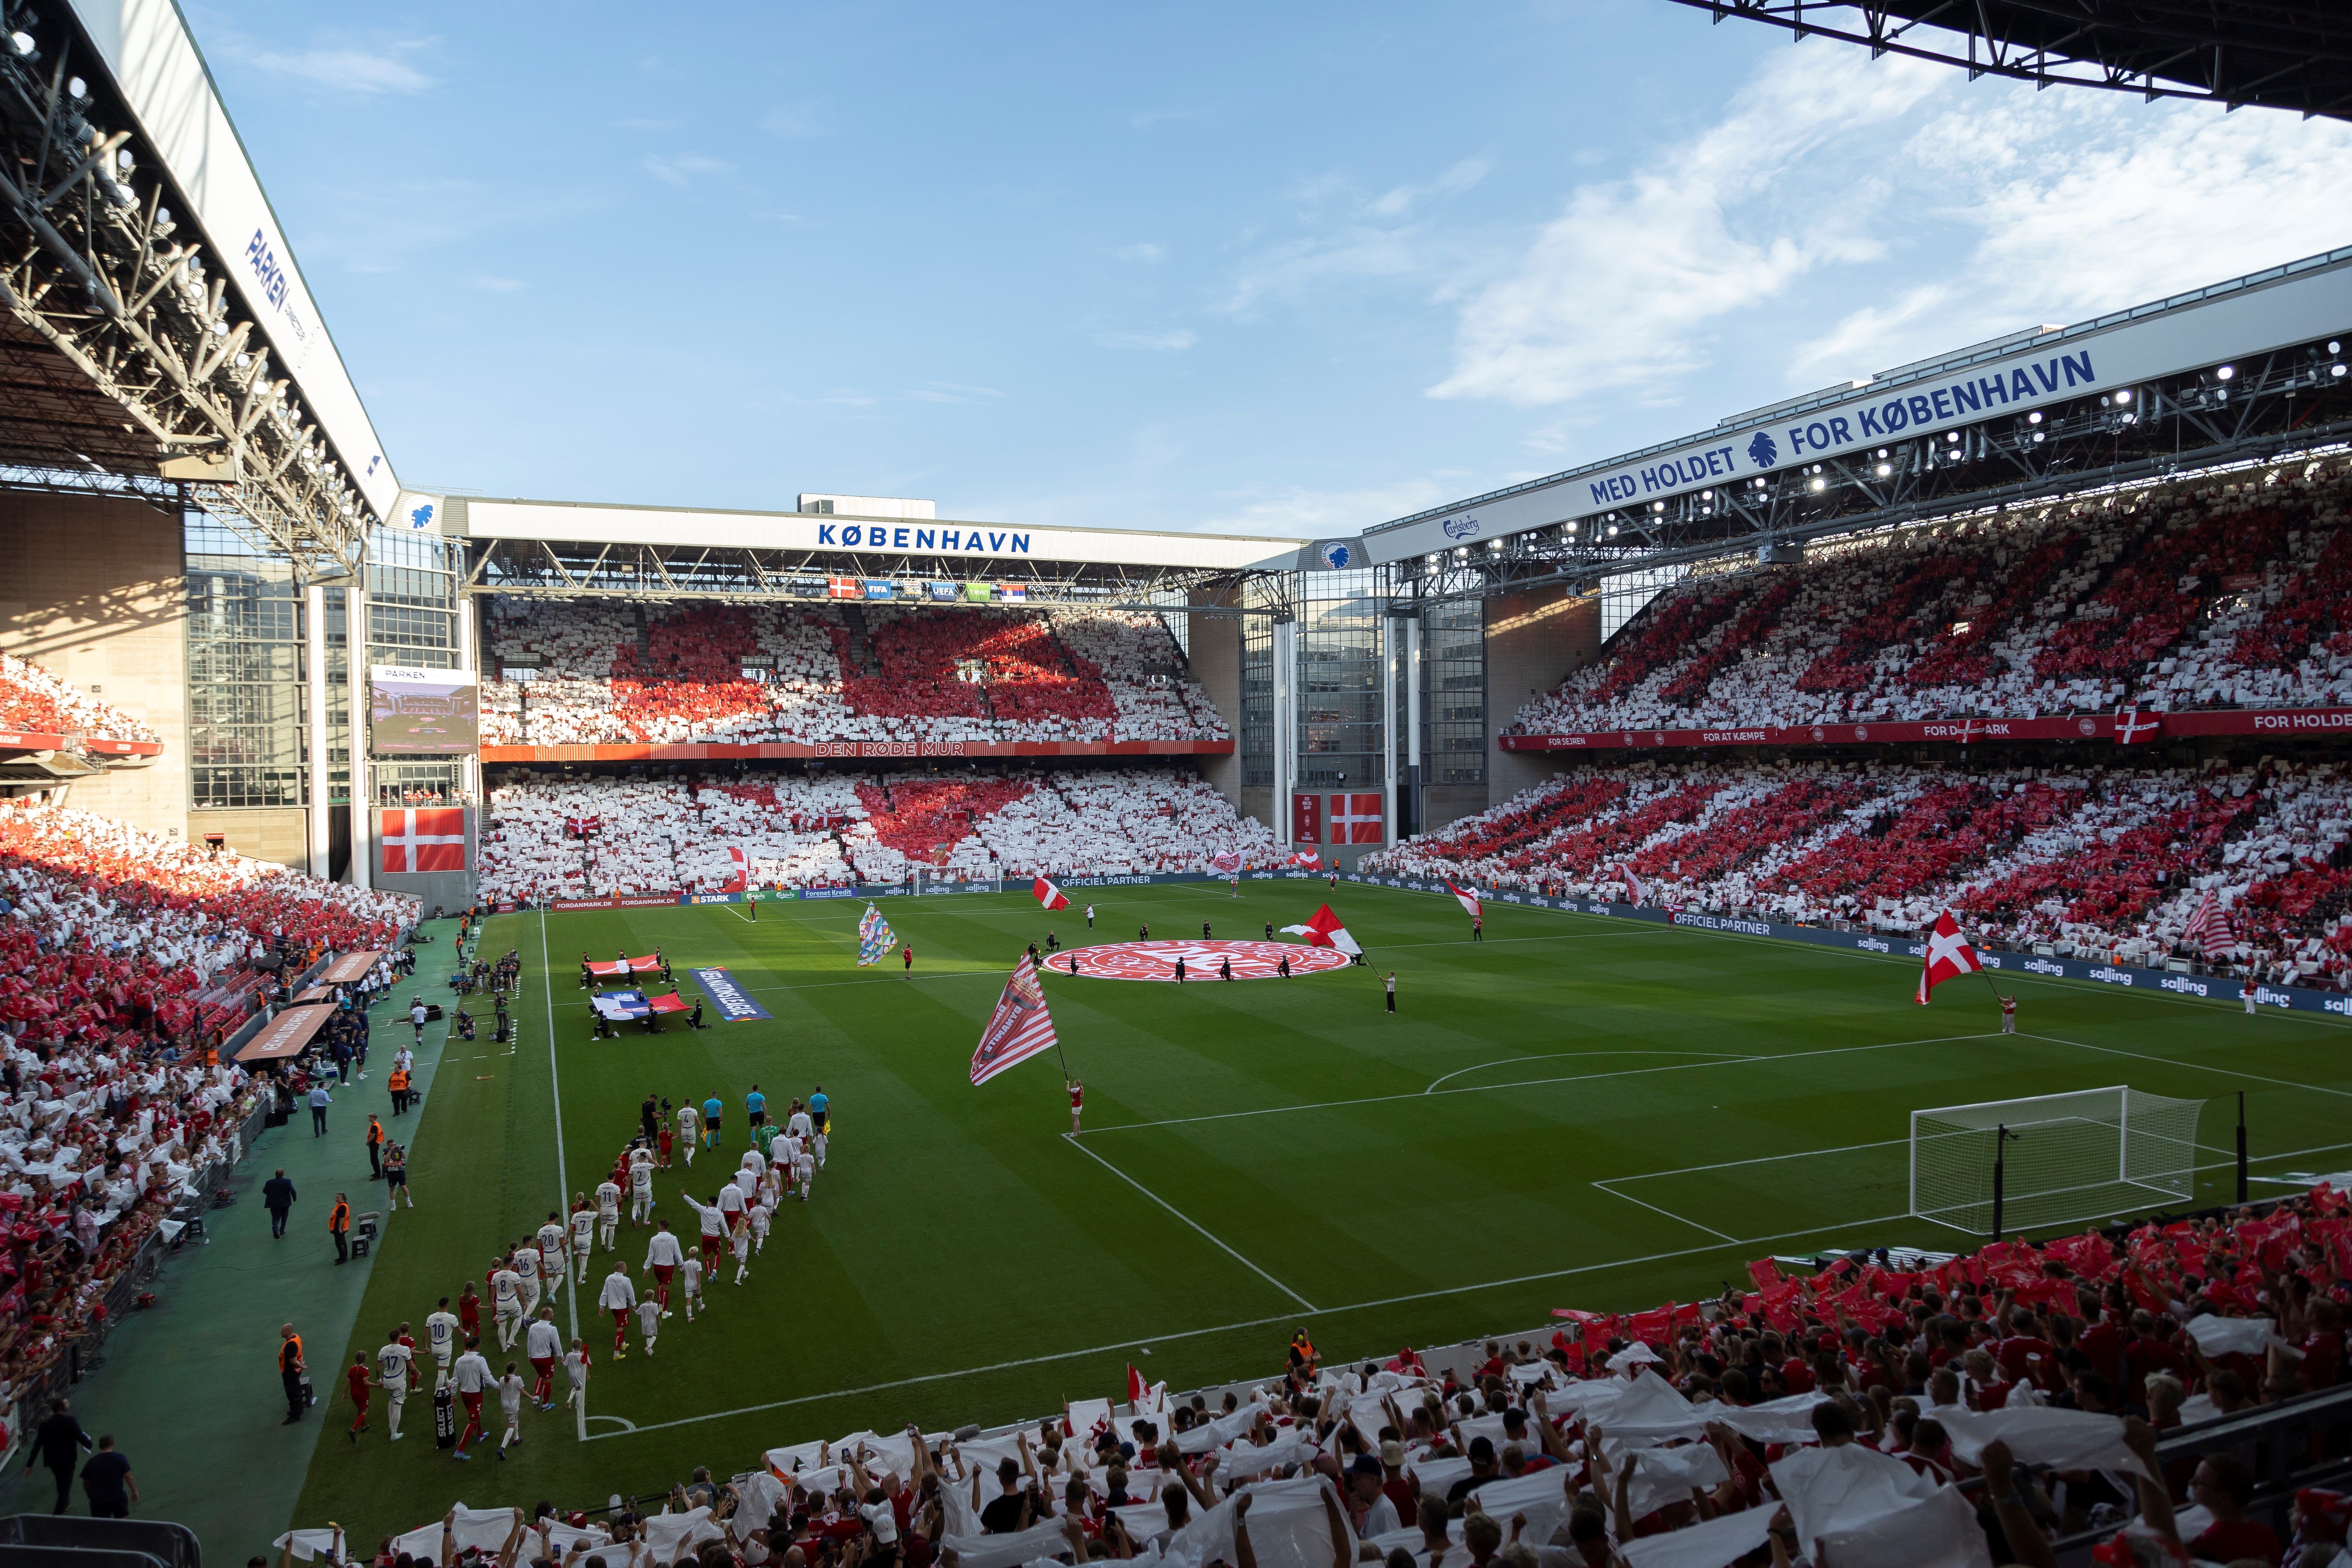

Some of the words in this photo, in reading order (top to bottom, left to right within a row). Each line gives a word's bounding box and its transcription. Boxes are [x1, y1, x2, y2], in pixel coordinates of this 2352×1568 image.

[245, 227, 290, 313] PARKEN
[1590, 475, 1636, 504] MED
[1644, 447, 1734, 492] HOLDET
[1789, 417, 1853, 454] FOR
[1858, 351, 2095, 436] KØBENHAVN
[1443, 517, 1480, 540] Carlsberg
[819, 525, 1029, 552] KØBENHAVN
[1323, 542, 1342, 552] KØBENHAVN
[386, 670, 425, 679] PARKEN
[2254, 716, 2289, 728] FOR
[1703, 733, 1720, 741] FOR
[1733, 731, 1766, 740] KÆMPE
[1924, 726, 1947, 736] FOR
[1949, 724, 2010, 735] DARK
[815, 742, 856, 757] DEN
[862, 742, 916, 757] RØDE
[921, 742, 964, 756] MUR
[1062, 878, 1102, 887] OFFICIEL
[1103, 876, 1150, 885] PARTNER
[1348, 873, 1360, 883] salling
[1367, 876, 1380, 885] salling
[1387, 878, 1400, 888] salling
[885, 887, 910, 896] salling
[926, 885, 950, 893] salling
[1408, 881, 1422, 890] salling
[1430, 883, 1445, 893] salling
[701, 895, 730, 903] STARK
[832, 889, 852, 897] Kredit
[1503, 893, 1520, 904] salling
[1530, 896, 1548, 907] salling
[1559, 899, 1577, 911] salling
[1590, 904, 1609, 915] salling
[1674, 913, 1718, 929] OFFICIEL
[1721, 918, 1770, 935] PARTNER
[1858, 937, 1889, 953] salling
[2024, 959, 2063, 976] salling
[699, 970, 724, 981] UEFA
[2089, 967, 2132, 986] salling
[705, 979, 740, 998] NATIONS
[2160, 976, 2207, 996] salling
[2238, 987, 2290, 1008] slling
[719, 996, 758, 1016] LEAGUE
[684, 1114, 689, 1124] 4
[767, 1132, 770, 1143] 1
[637, 1171, 643, 1181] 2
[603, 1191, 611, 1203] 11
[580, 1220, 586, 1232] 7
[542, 1234, 554, 1247] 20
[518, 1258, 529, 1271] 16
[500, 1279, 506, 1293] 8
[432, 1323, 445, 1338] 10
[385, 1356, 398, 1370] 17
[436, 1406, 446, 1437] SELECT
